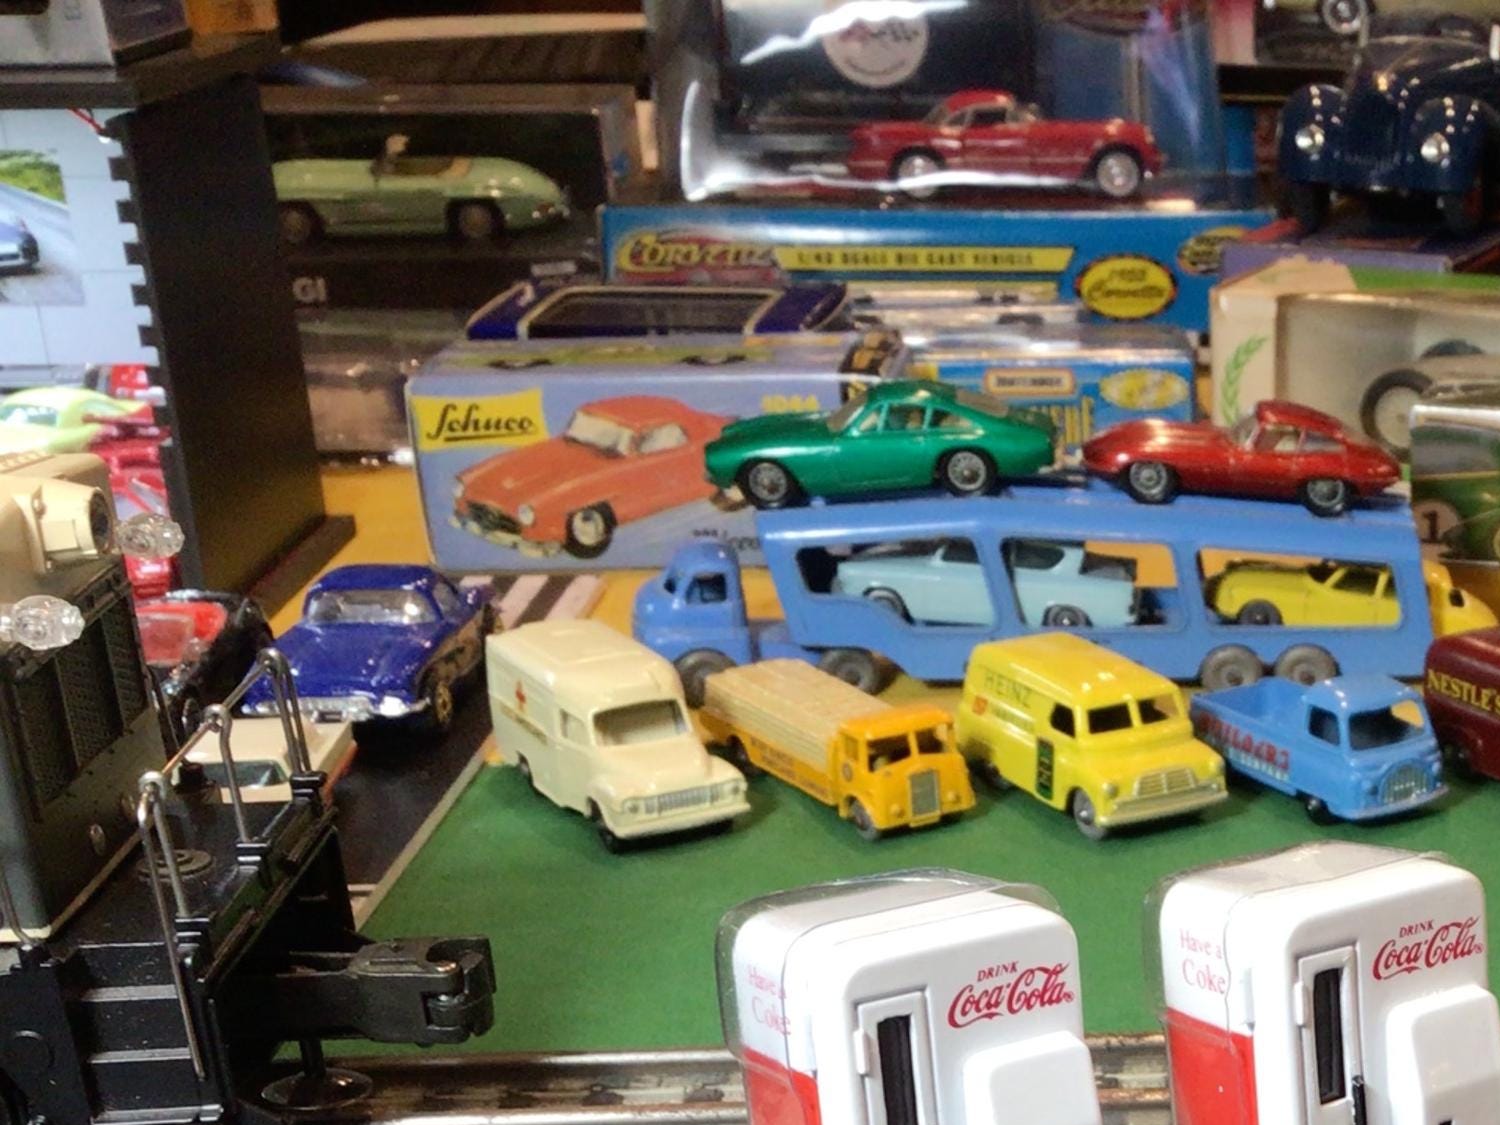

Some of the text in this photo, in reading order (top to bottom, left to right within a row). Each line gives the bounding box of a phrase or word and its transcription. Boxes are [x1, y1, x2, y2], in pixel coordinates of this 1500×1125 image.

[425, 402, 537, 441] Schuco
[984, 671, 1033, 709] HEINZ
[1179, 927, 1212, 956] Have
[1399, 919, 1435, 939] DRINK
[1371, 916, 1484, 981] Coca-Cola
[976, 960, 1020, 983] DRINK
[1181, 958, 1226, 995] Coke
[947, 961, 1074, 1029] Coca-Cola
[751, 995, 792, 1036] Coke
